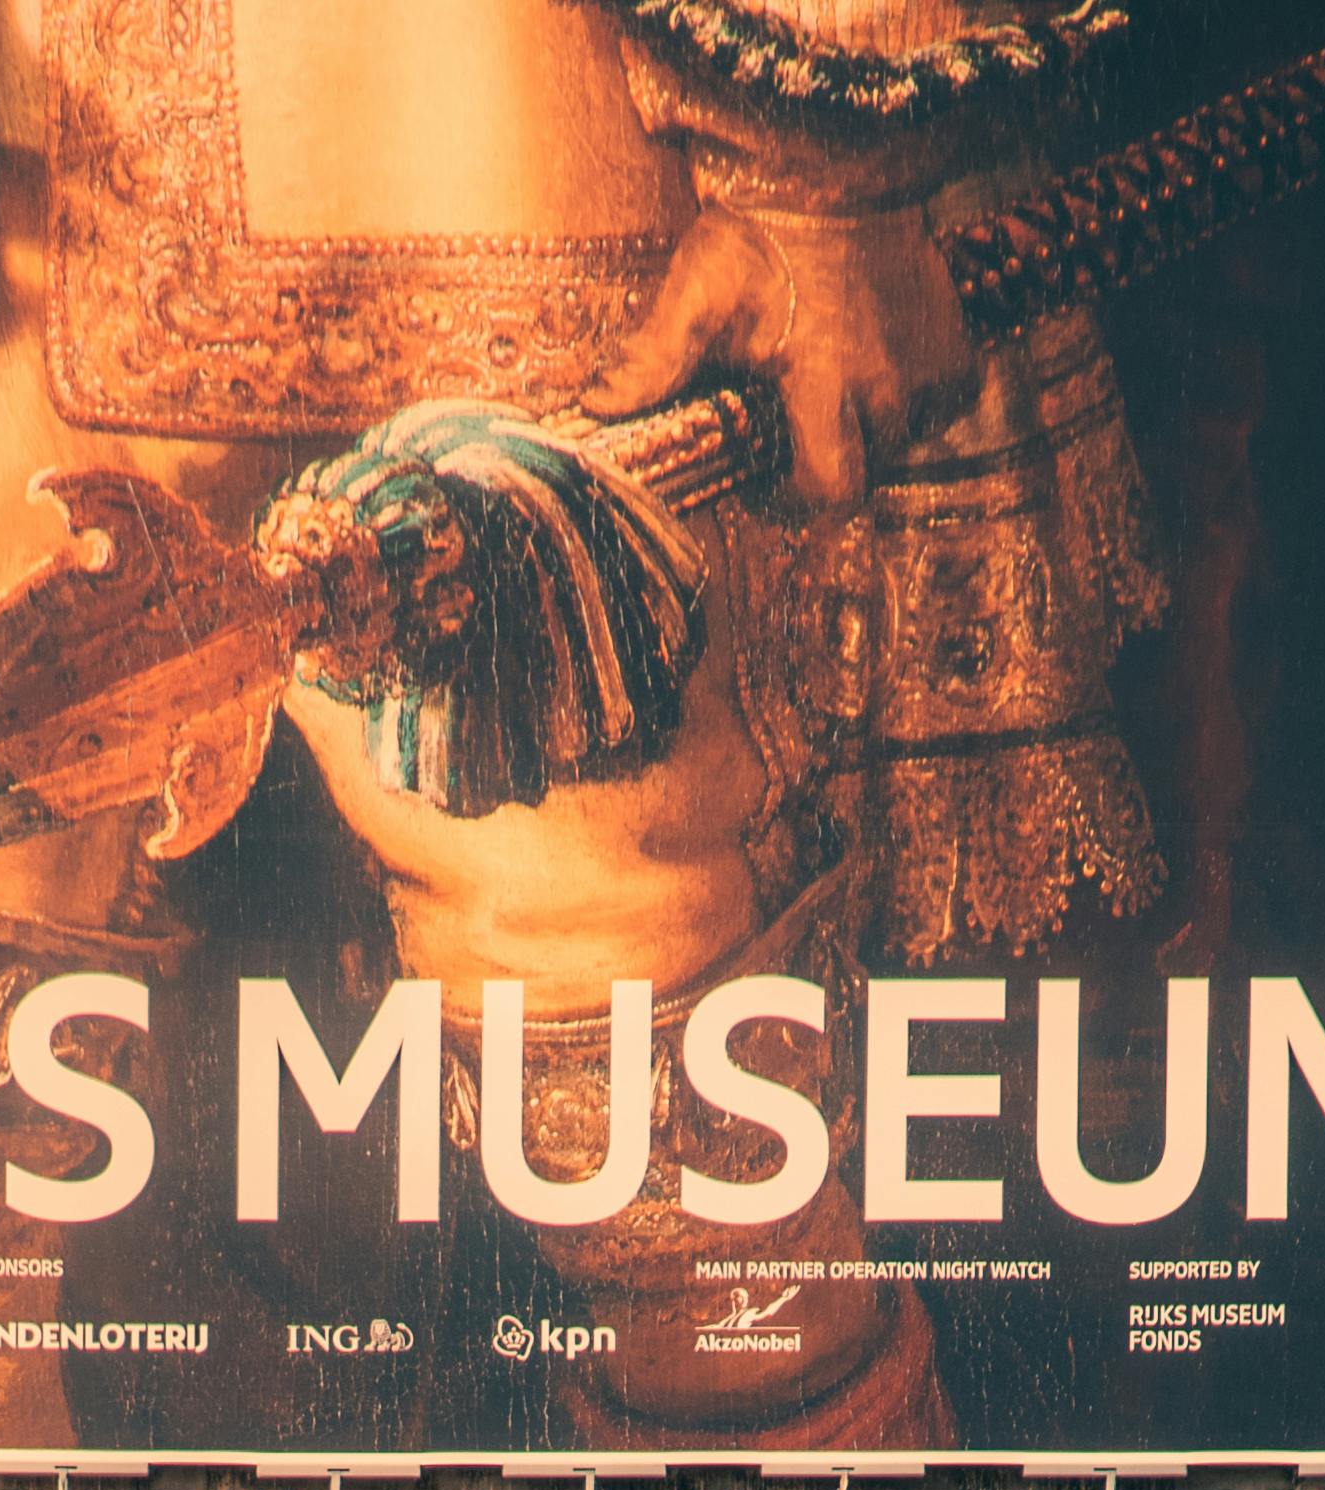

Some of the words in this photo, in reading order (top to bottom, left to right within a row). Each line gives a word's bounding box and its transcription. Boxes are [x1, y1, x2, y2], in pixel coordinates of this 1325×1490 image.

[696, 1262, 740, 1279] MAIN
[746, 1262, 824, 1279] PARTNER
[830, 1262, 926, 1279] OPERATION
[932, 1262, 985, 1279] NIGHT
[990, 1262, 1050, 1279] WATCH
[1129, 1262, 1230, 1279] SUPPORTED
[1236, 1262, 1259, 1279] BY
[1191, 1304, 1284, 1326] MUSEUM
[287, 1325, 360, 1353] ING
[540, 1319, 616, 1358] kpn
[695, 1333, 801, 1351] AkzoNobel
[1129, 1331, 1201, 1351] FONDS
